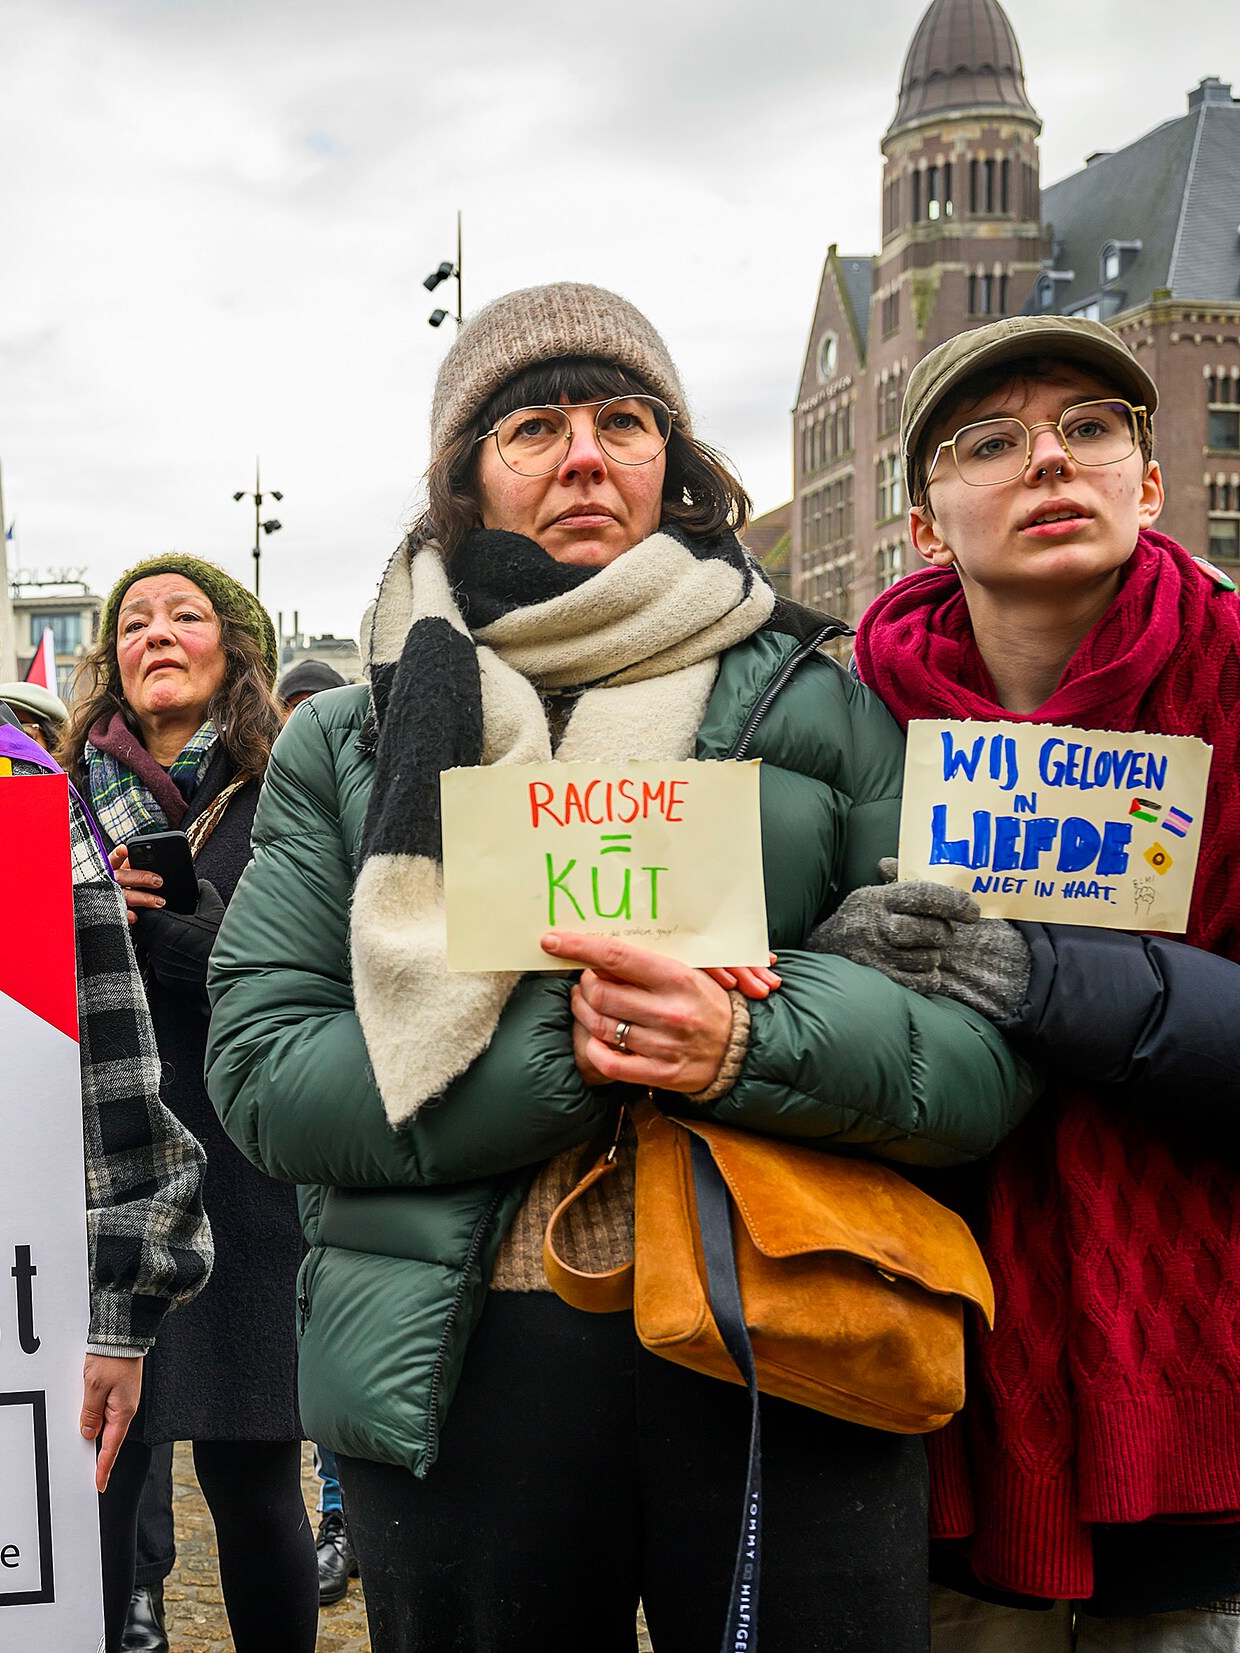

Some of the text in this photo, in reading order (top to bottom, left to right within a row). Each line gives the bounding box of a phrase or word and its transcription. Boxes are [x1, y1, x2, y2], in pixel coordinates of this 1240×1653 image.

[941, 731, 1168, 791] WIJ GELOVEN
[528, 779, 689, 828] RACISME
[1014, 792, 1037, 814] IN
[929, 804, 1133, 876] LIEFDE
[546, 853, 669, 926] KUT
[972, 876, 1028, 894] NIET
[1034, 881, 1055, 897] IN
[1061, 881, 1117, 904] HAAT.
[735, 1492, 758, 1653] TOMMY HILFIGE
